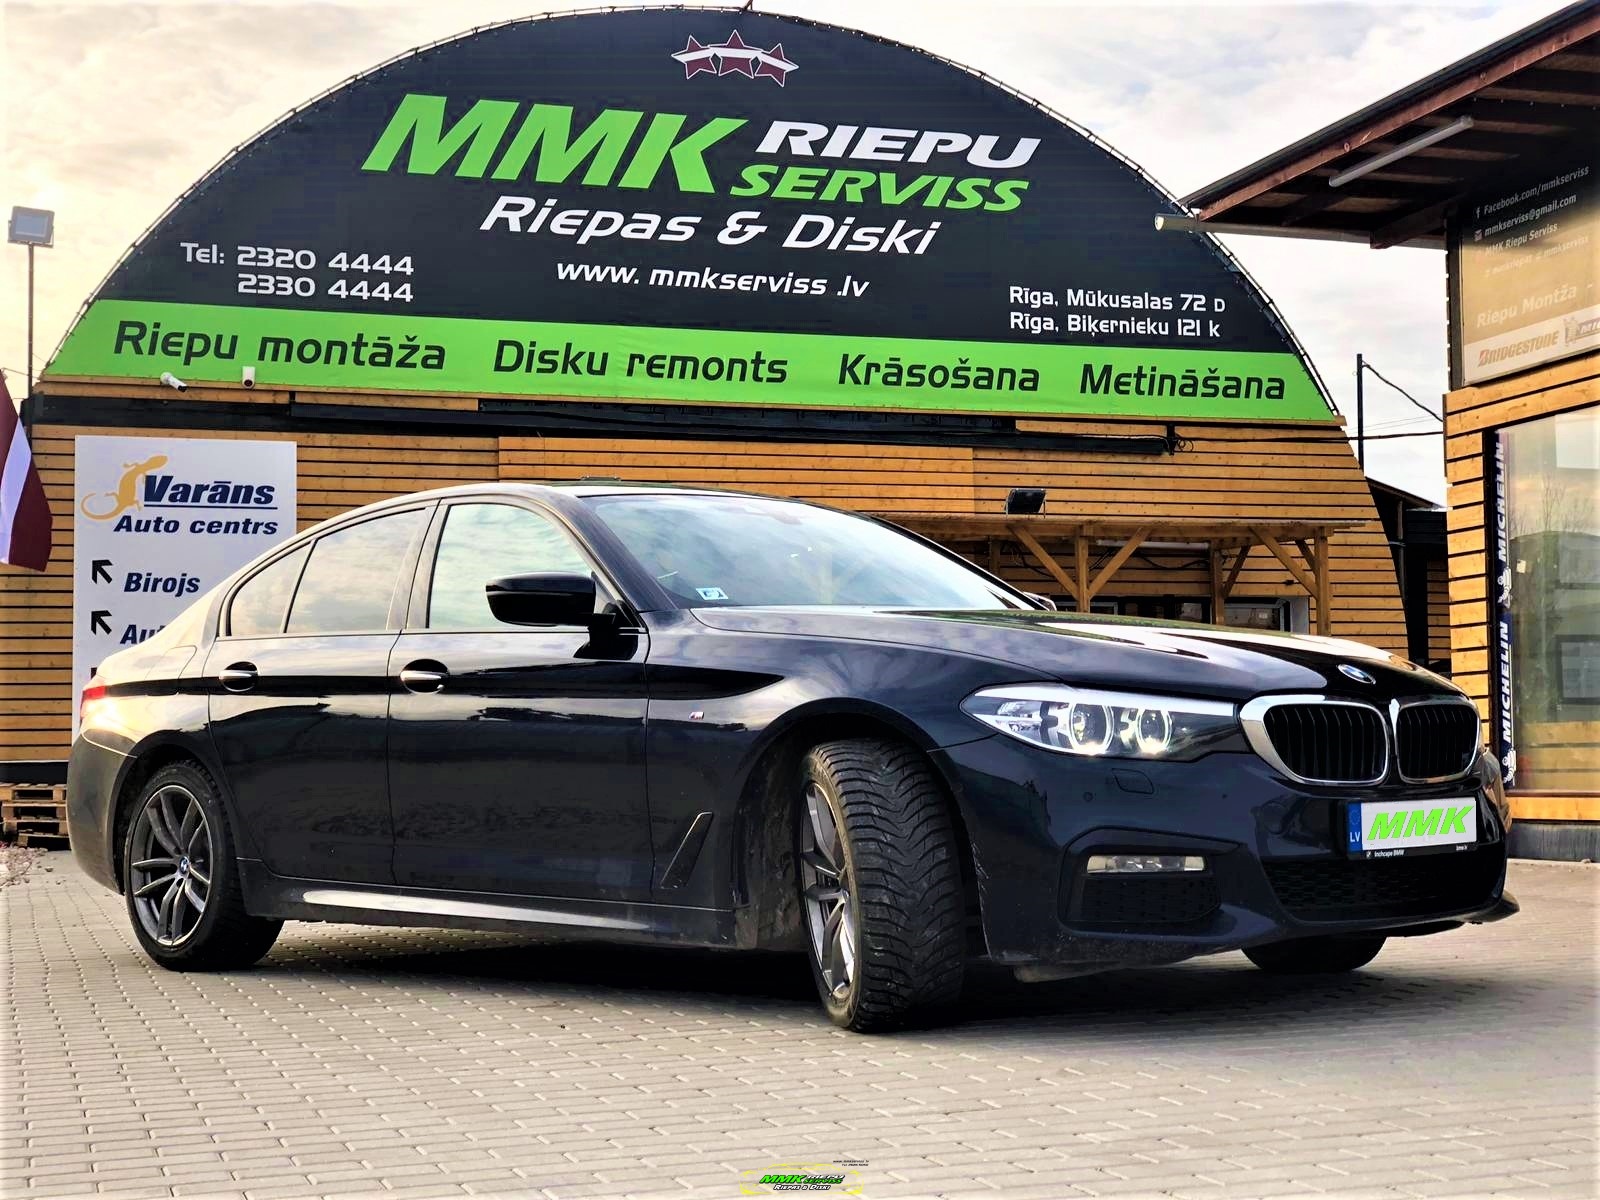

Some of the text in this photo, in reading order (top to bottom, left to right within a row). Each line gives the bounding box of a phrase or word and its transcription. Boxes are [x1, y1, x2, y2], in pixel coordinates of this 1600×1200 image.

[361, 93, 748, 194] MMK
[755, 119, 1042, 170] RIEPU
[730, 164, 1031, 213] SERVISS
[479, 195, 943, 256] Riepas & Diski
[1484, 194, 1577, 238] mmkserviss@gmail.com
[1505, 232, 1528, 250] Riepu
[1529, 223, 1559, 242] Serviss
[180, 241, 415, 277] Tel: 2320 4444
[236, 273, 415, 304] 2330 4444
[648, 267, 828, 298] mmkserviss
[1066, 288, 1174, 313] Mūkusalas
[1179, 293, 1207, 313] 72
[1476, 304, 1519, 330] Riepu
[113, 320, 447, 371] Riepu montāža
[493, 339, 790, 384] Disku remonts
[1477, 330, 1560, 368] BRIDGESTONE
[838, 352, 1041, 393] Krāsošana
[1079, 363, 1287, 400] Metināšana
[144, 475, 275, 505] Varāns
[1495, 442, 1507, 562] MICHELIN
[114, 515, 278, 535] Auto centrs
[124, 572, 201, 597] Birojs
[1500, 620, 1512, 744] MICHELIN
[1350, 832, 1361, 843] LV
